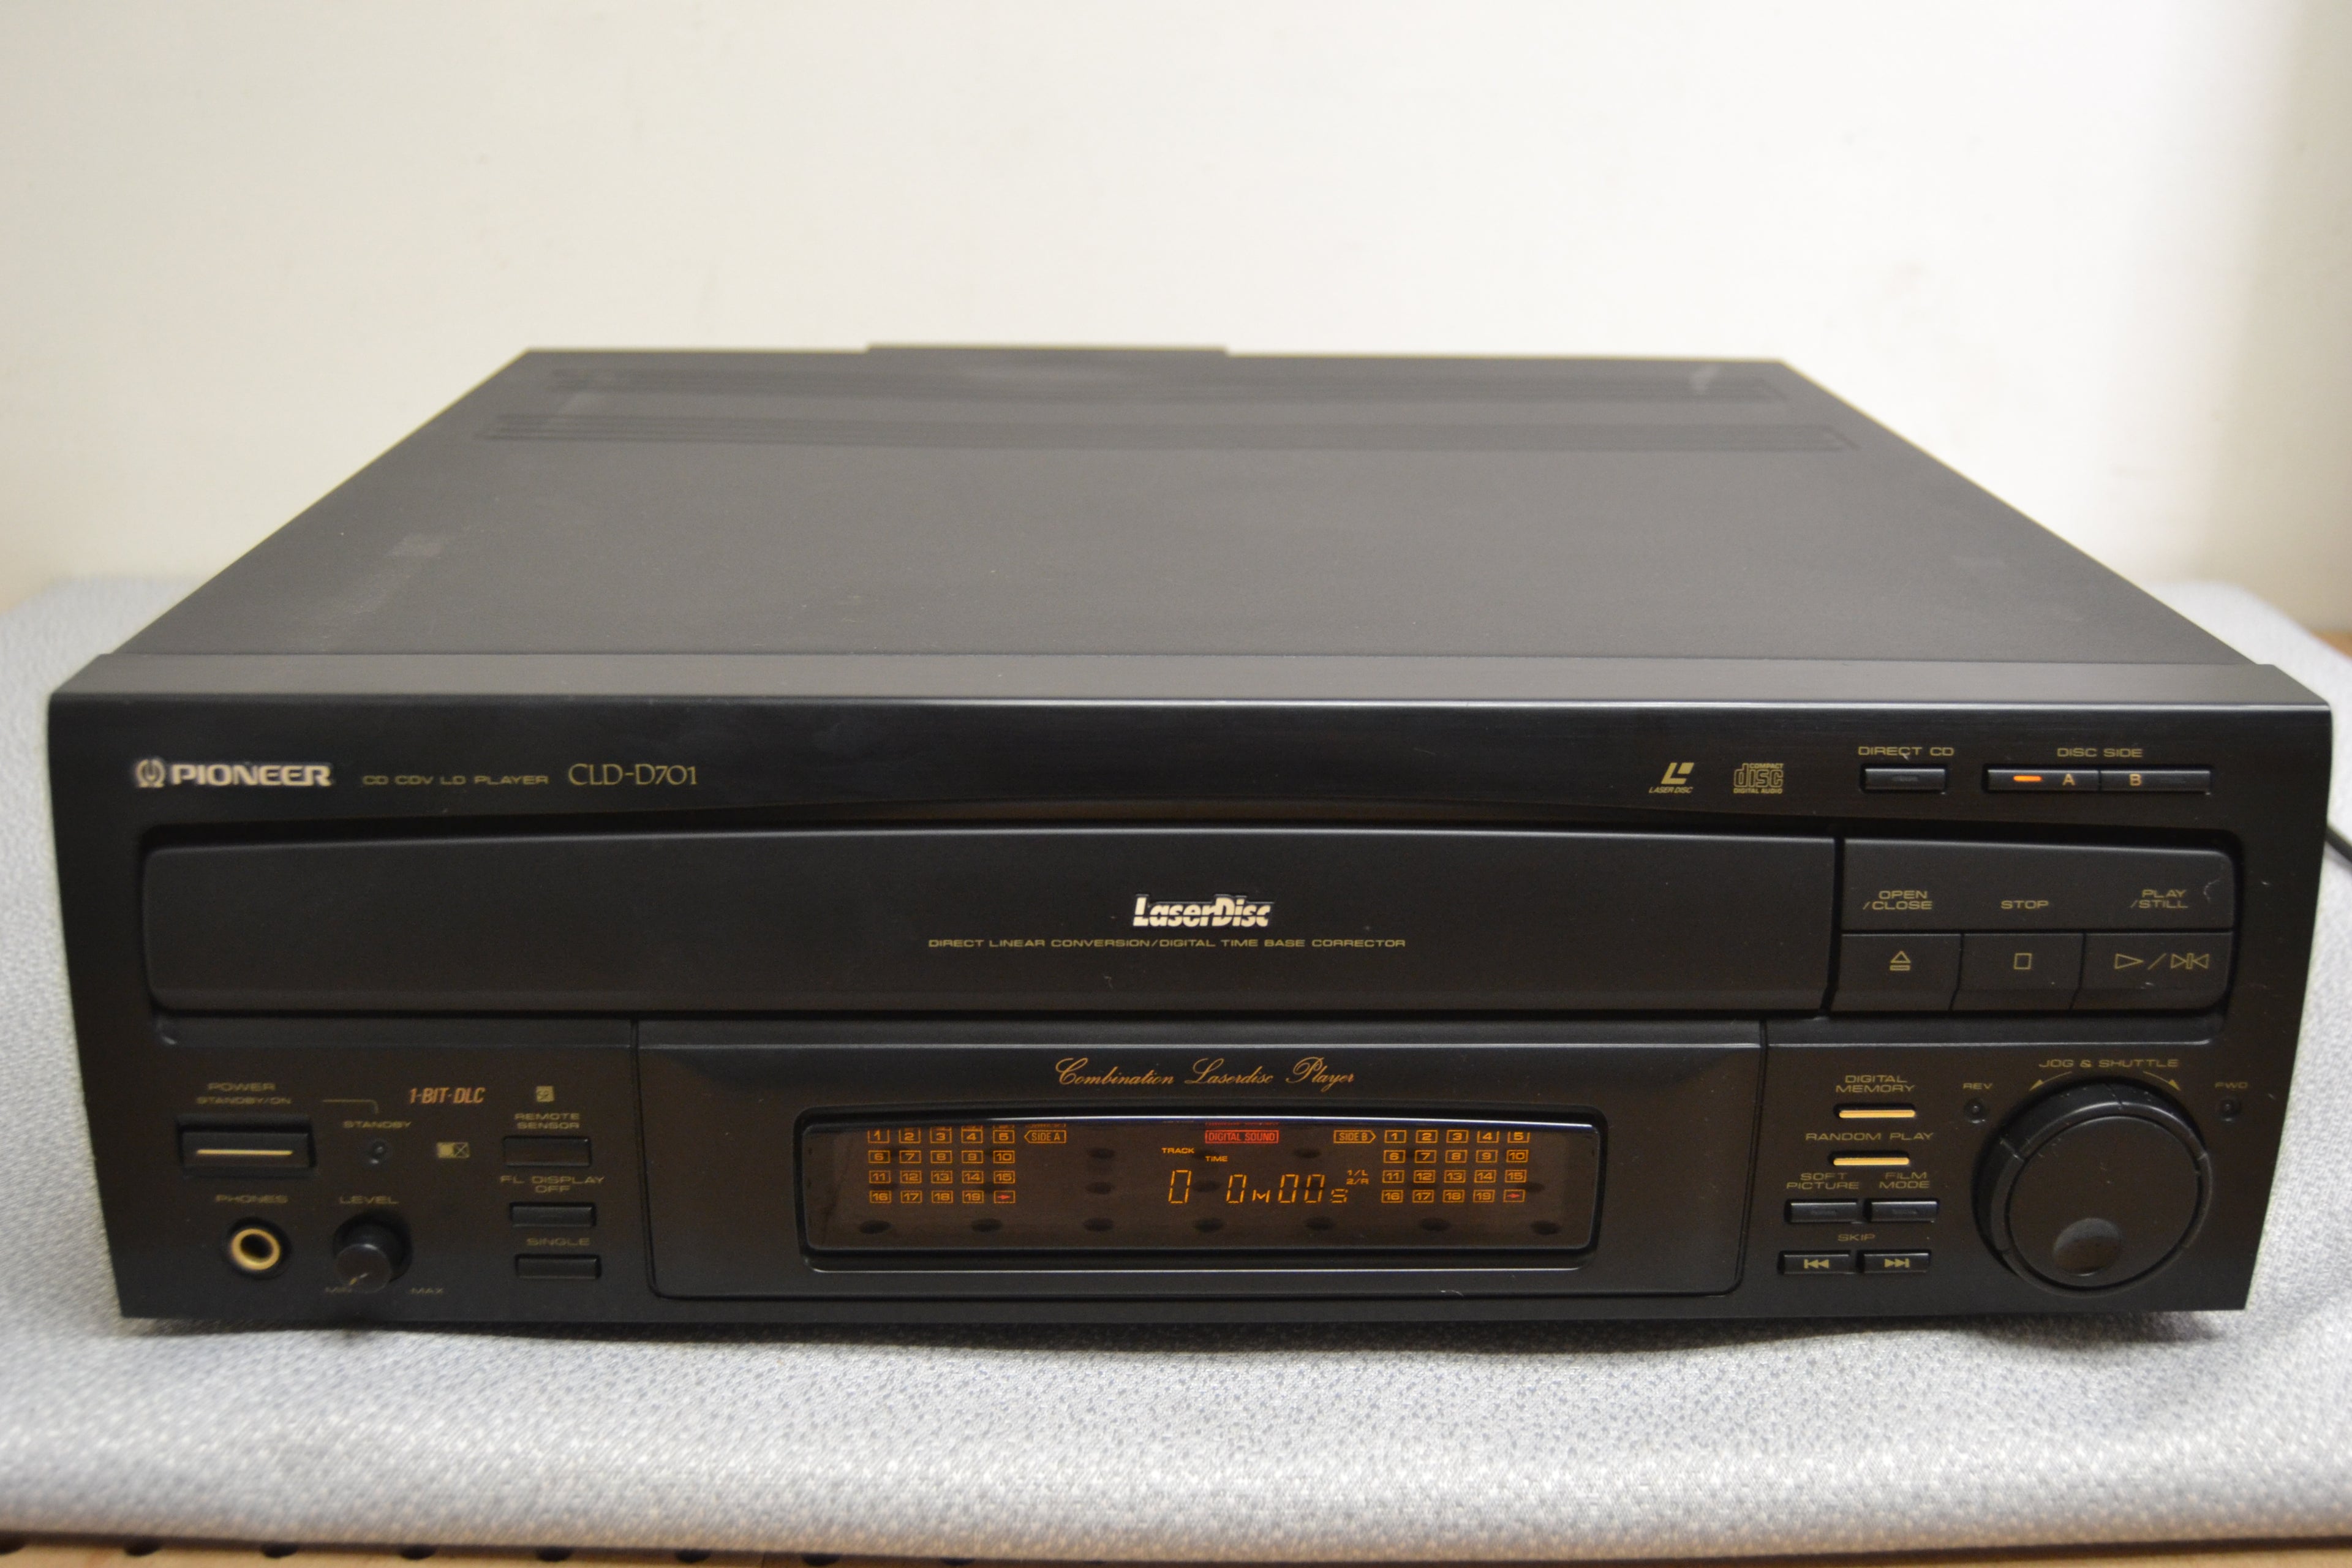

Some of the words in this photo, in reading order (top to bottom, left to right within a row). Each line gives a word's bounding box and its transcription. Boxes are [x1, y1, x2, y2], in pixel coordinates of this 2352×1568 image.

[1858, 746, 1922, 756] DIRECT
[1930, 747, 1954, 756] CD
[2057, 748, 2098, 758] DISC
[2103, 748, 2143, 758] SIDE
[172, 763, 333, 787] PIONEER
[568, 763, 698, 786] CLD-D701
[363, 775, 388, 785] CD
[396, 775, 434, 785] CDV
[441, 775, 466, 785] LD
[474, 775, 549, 785] PLAYER
[2062, 774, 2075, 786] A
[2130, 774, 2142, 786] B
[1879, 891, 1928, 899] OPEN
[2142, 889, 2187, 898] PLAY
[2001, 900, 2049, 909] STOP
[1132, 896, 1272, 927] LaserDisc
[928, 939, 984, 948] DIRECT
[990, 939, 1046, 948] LINEAR
[1221, 939, 1258, 948] TIME
[1264, 939, 1306, 948] BASE
[1312, 939, 1406, 948] CORRECTOR
[2039, 1059, 2074, 1068] JOG
[2080, 1060, 2092, 1068] &
[2099, 1059, 2180, 1068] SHUTTLE
[1055, 1058, 1174, 1085] Combination
[1185, 1058, 1273, 1085] Laserdisc
[1286, 1057, 1355, 1092] Player
[1845, 1075, 1908, 1084] DIGITAL
[208, 1082, 276, 1091] POWER
[1836, 1085, 1915, 1093] MEMORY
[514, 1112, 580, 1121] REMOTE
[1031, 1133, 1052, 1141] SIDE
[1054, 1133, 1061, 1141] A
[1208, 1133, 1241, 1142] DIGITAL
[1245, 1133, 1275, 1142] SOUND
[1339, 1133, 1360, 1141] SIDE
[1362, 1133, 1368, 1141] B
[1805, 1133, 1881, 1141] RANDOM
[1890, 1132, 1934, 1140] PLAY
[532, 1175, 605, 1184] DISPLAY
[1800, 1172, 1848, 1181] SOFT
[216, 1194, 289, 1204] PHONES
[339, 1196, 399, 1204] LEVEL
